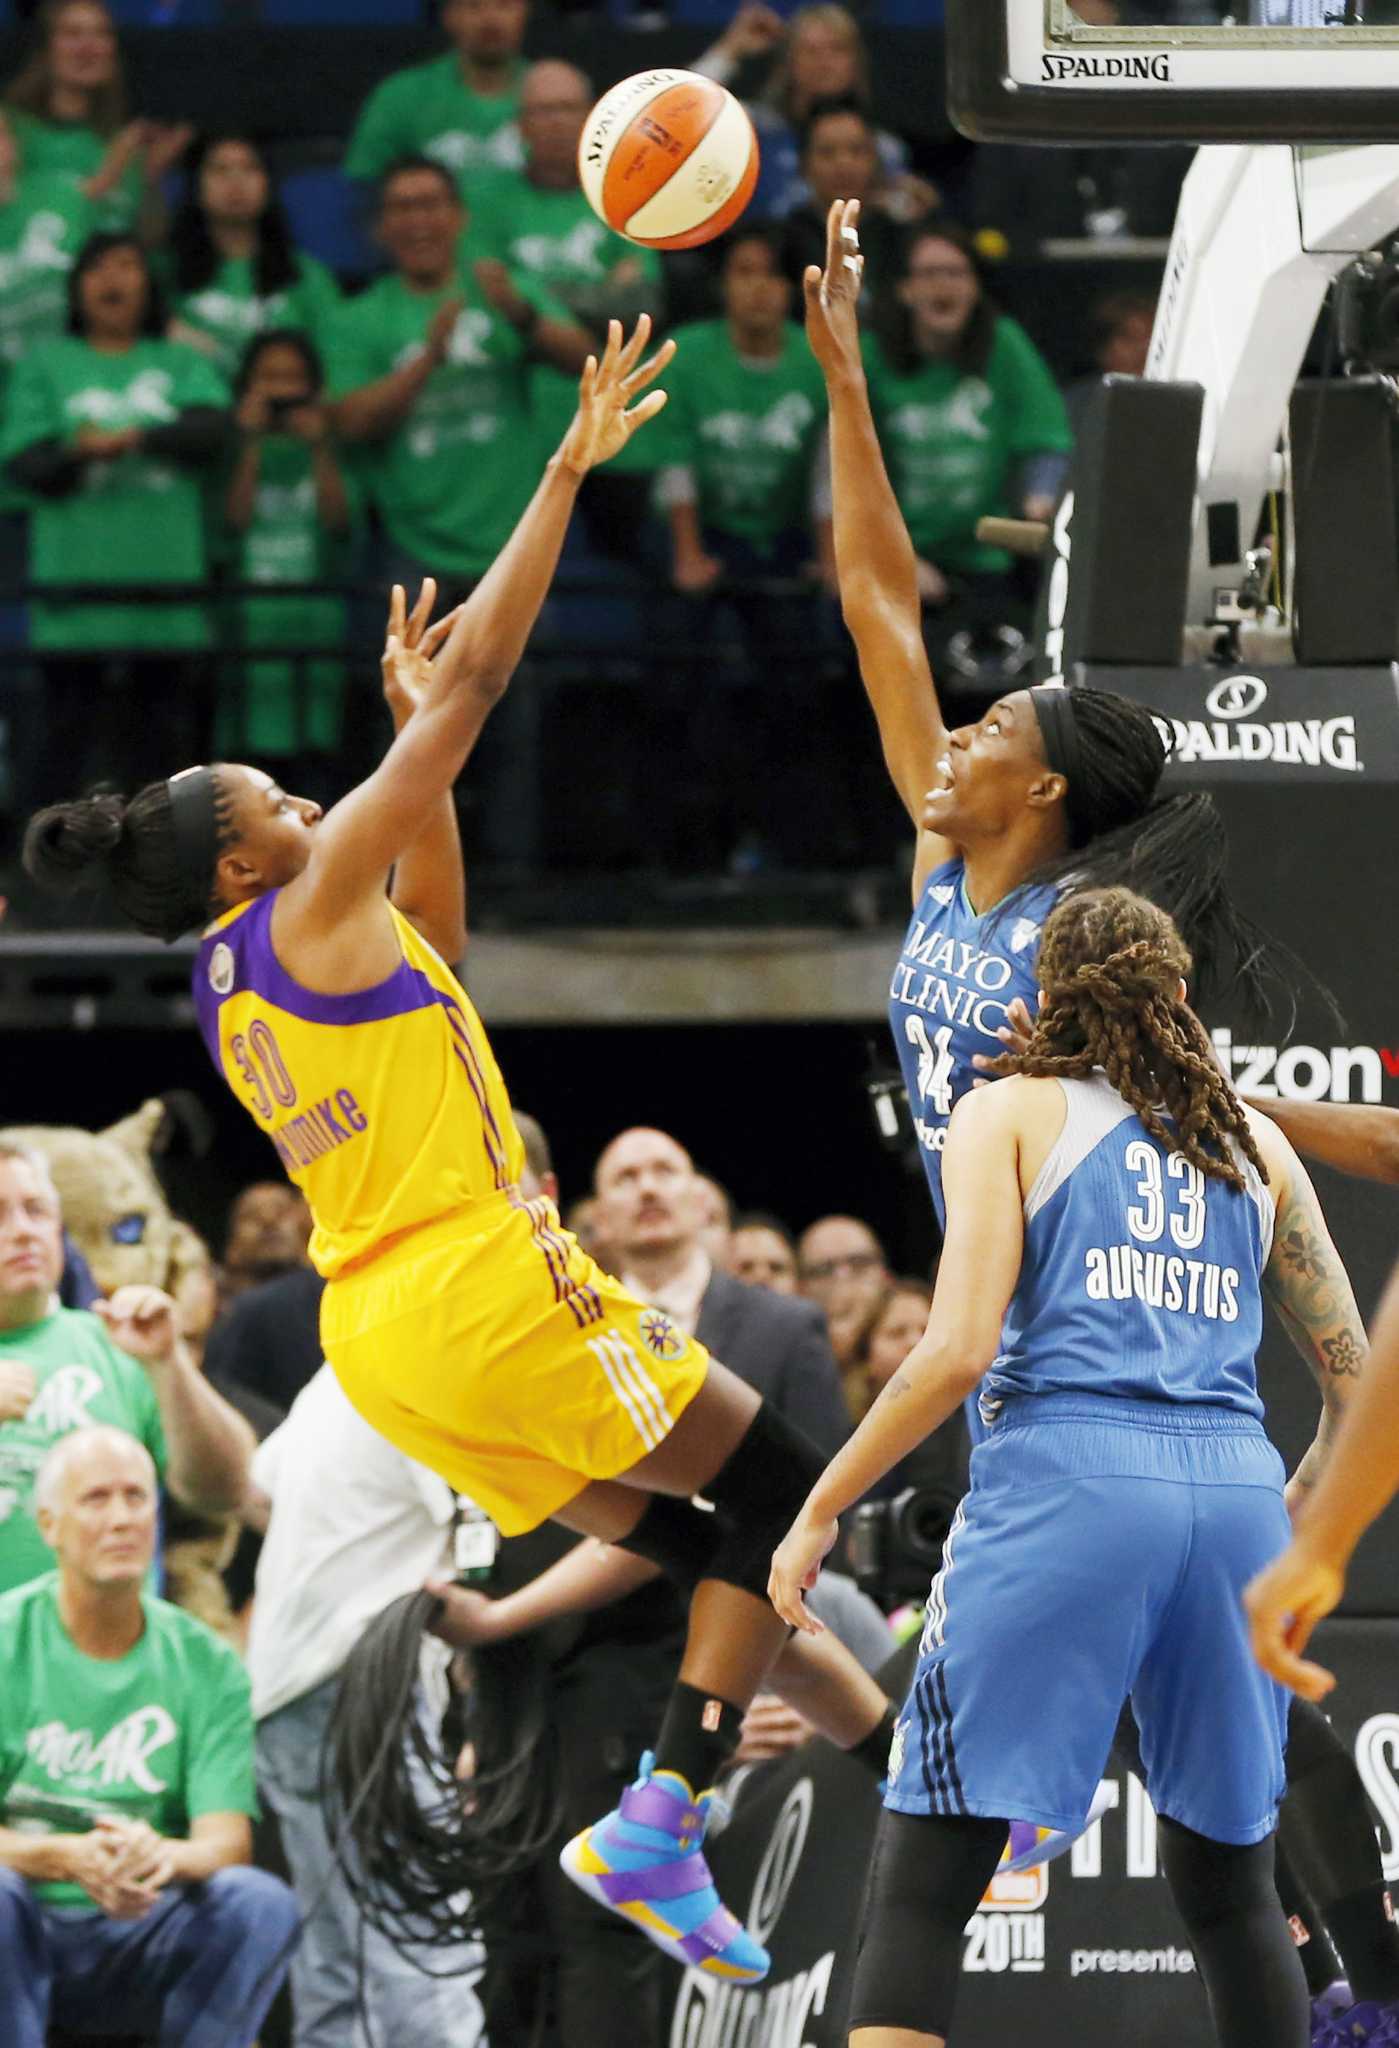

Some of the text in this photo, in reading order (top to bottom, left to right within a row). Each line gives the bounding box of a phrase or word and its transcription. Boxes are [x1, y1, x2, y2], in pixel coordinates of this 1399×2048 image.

[1041, 54, 1169, 82] SPALDING
[587, 73, 676, 169] SPALING
[1150, 716, 1358, 771] PALDING
[904, 921, 1013, 992] MAYO
[890, 962, 1010, 1038] CLINIC
[231, 1019, 297, 1120] 30
[904, 1014, 955, 1115] 24
[1211, 1028, 1383, 1103] izon
[1124, 1140, 1208, 1250] 33
[962, 1913, 1045, 1973] 20TH
[1070, 1945, 1198, 1977] presente
